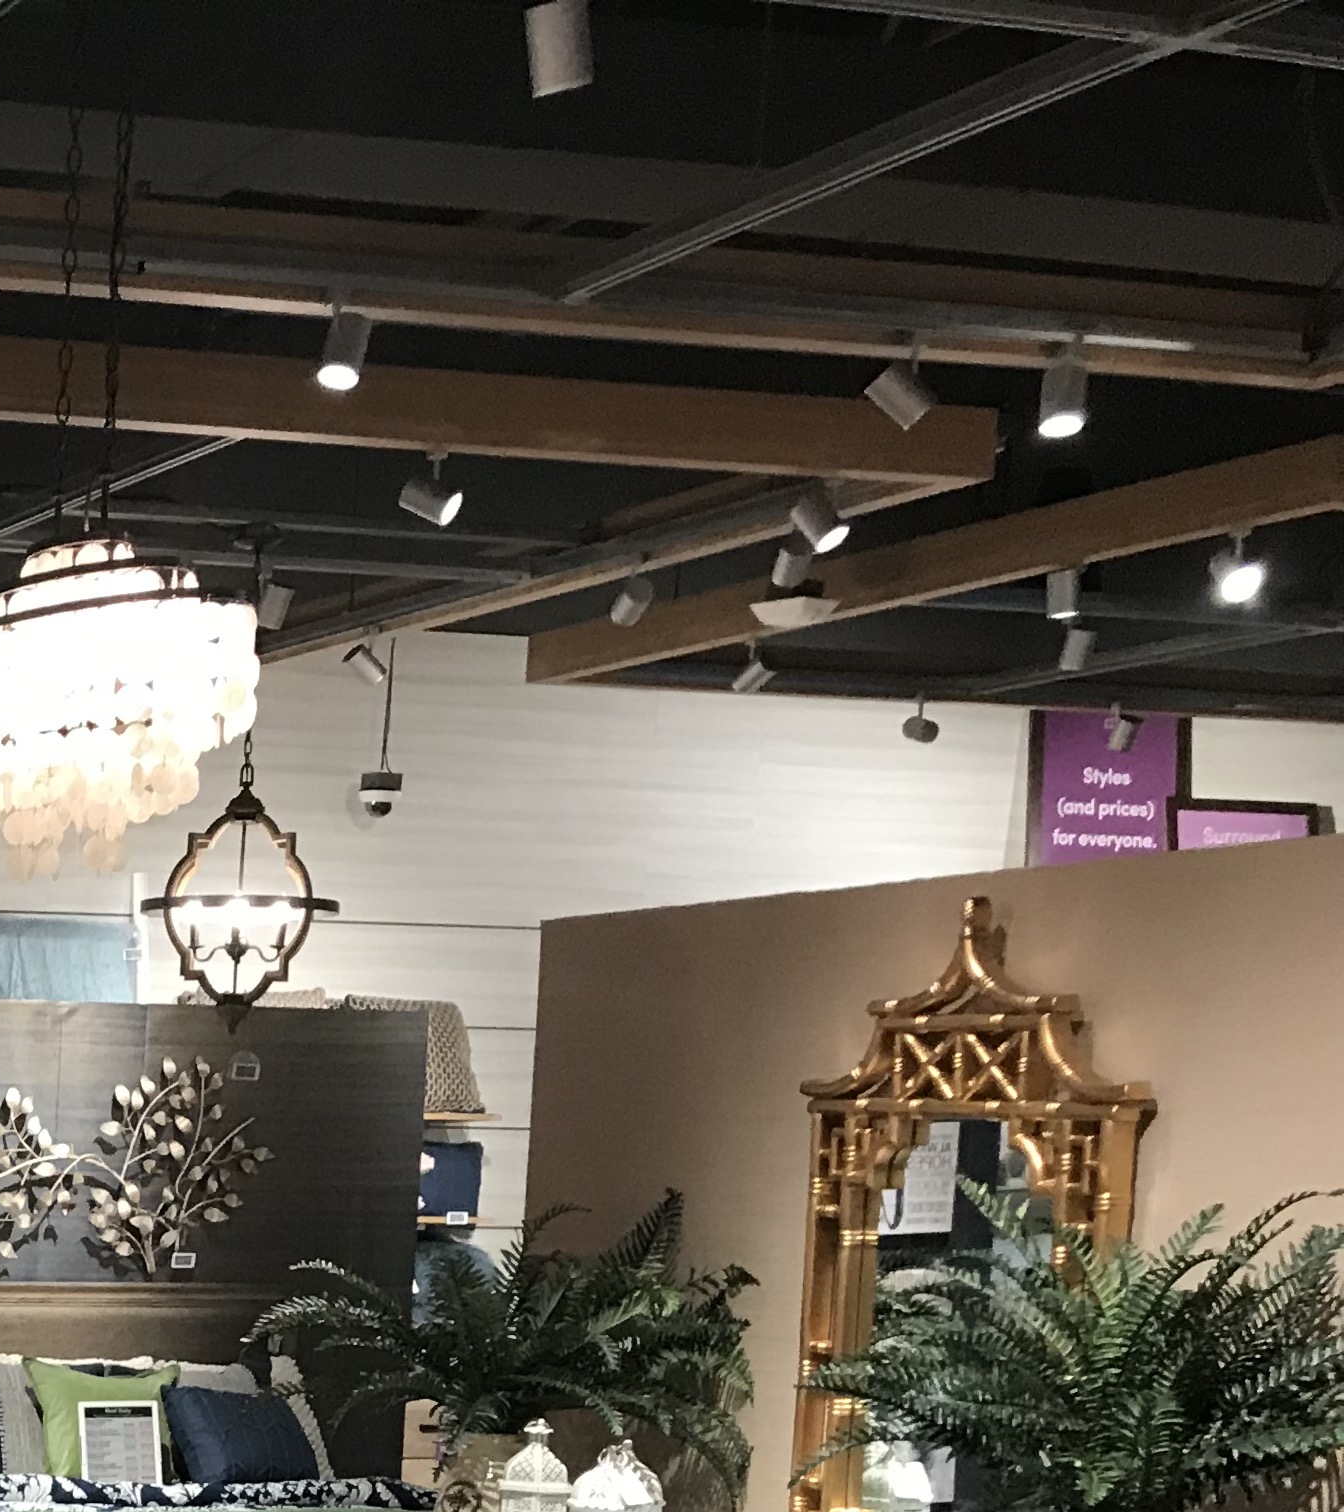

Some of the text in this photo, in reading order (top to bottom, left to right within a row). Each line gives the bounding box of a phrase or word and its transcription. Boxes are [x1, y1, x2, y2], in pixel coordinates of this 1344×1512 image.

[1083, 766, 1132, 789] Styles
[1057, 797, 1155, 821] (and prices)
[1052, 828, 1157, 852] for everyone.
